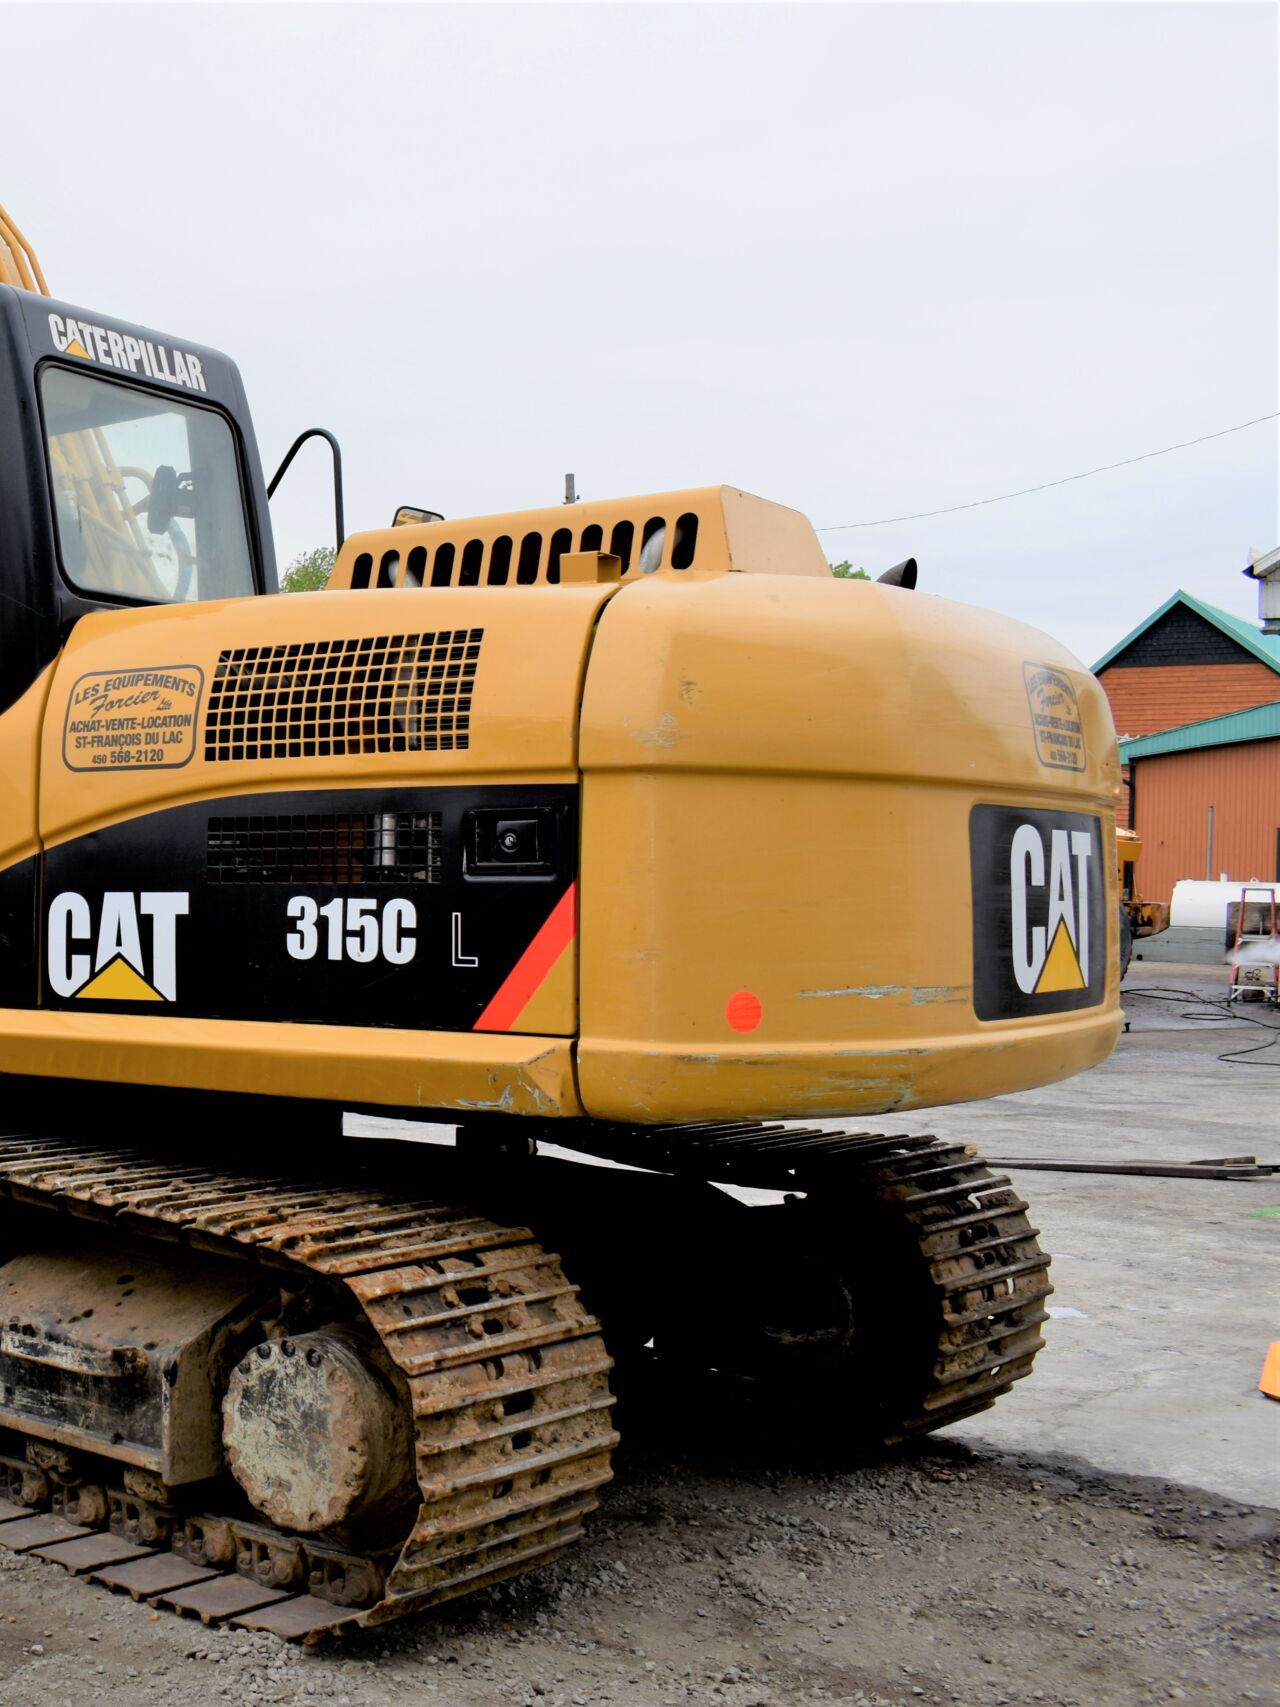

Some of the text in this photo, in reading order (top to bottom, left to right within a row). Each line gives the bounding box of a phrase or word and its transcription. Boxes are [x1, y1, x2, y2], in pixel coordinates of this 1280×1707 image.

[48, 313, 207, 392] CATERPILLAR
[74, 673, 196, 705] LES EQUIPEMENTS
[89, 689, 161, 719] Forcier
[69, 714, 192, 733] ACHAT-VENTE-LOCATION
[75, 730, 183, 750] ST-FRANÇOIS DU LAC
[91, 749, 164, 764] 450 568-2120
[1010, 824, 1092, 994] CAT
[48, 891, 189, 1001] CAT
[286, 896, 478, 967] 315C L
